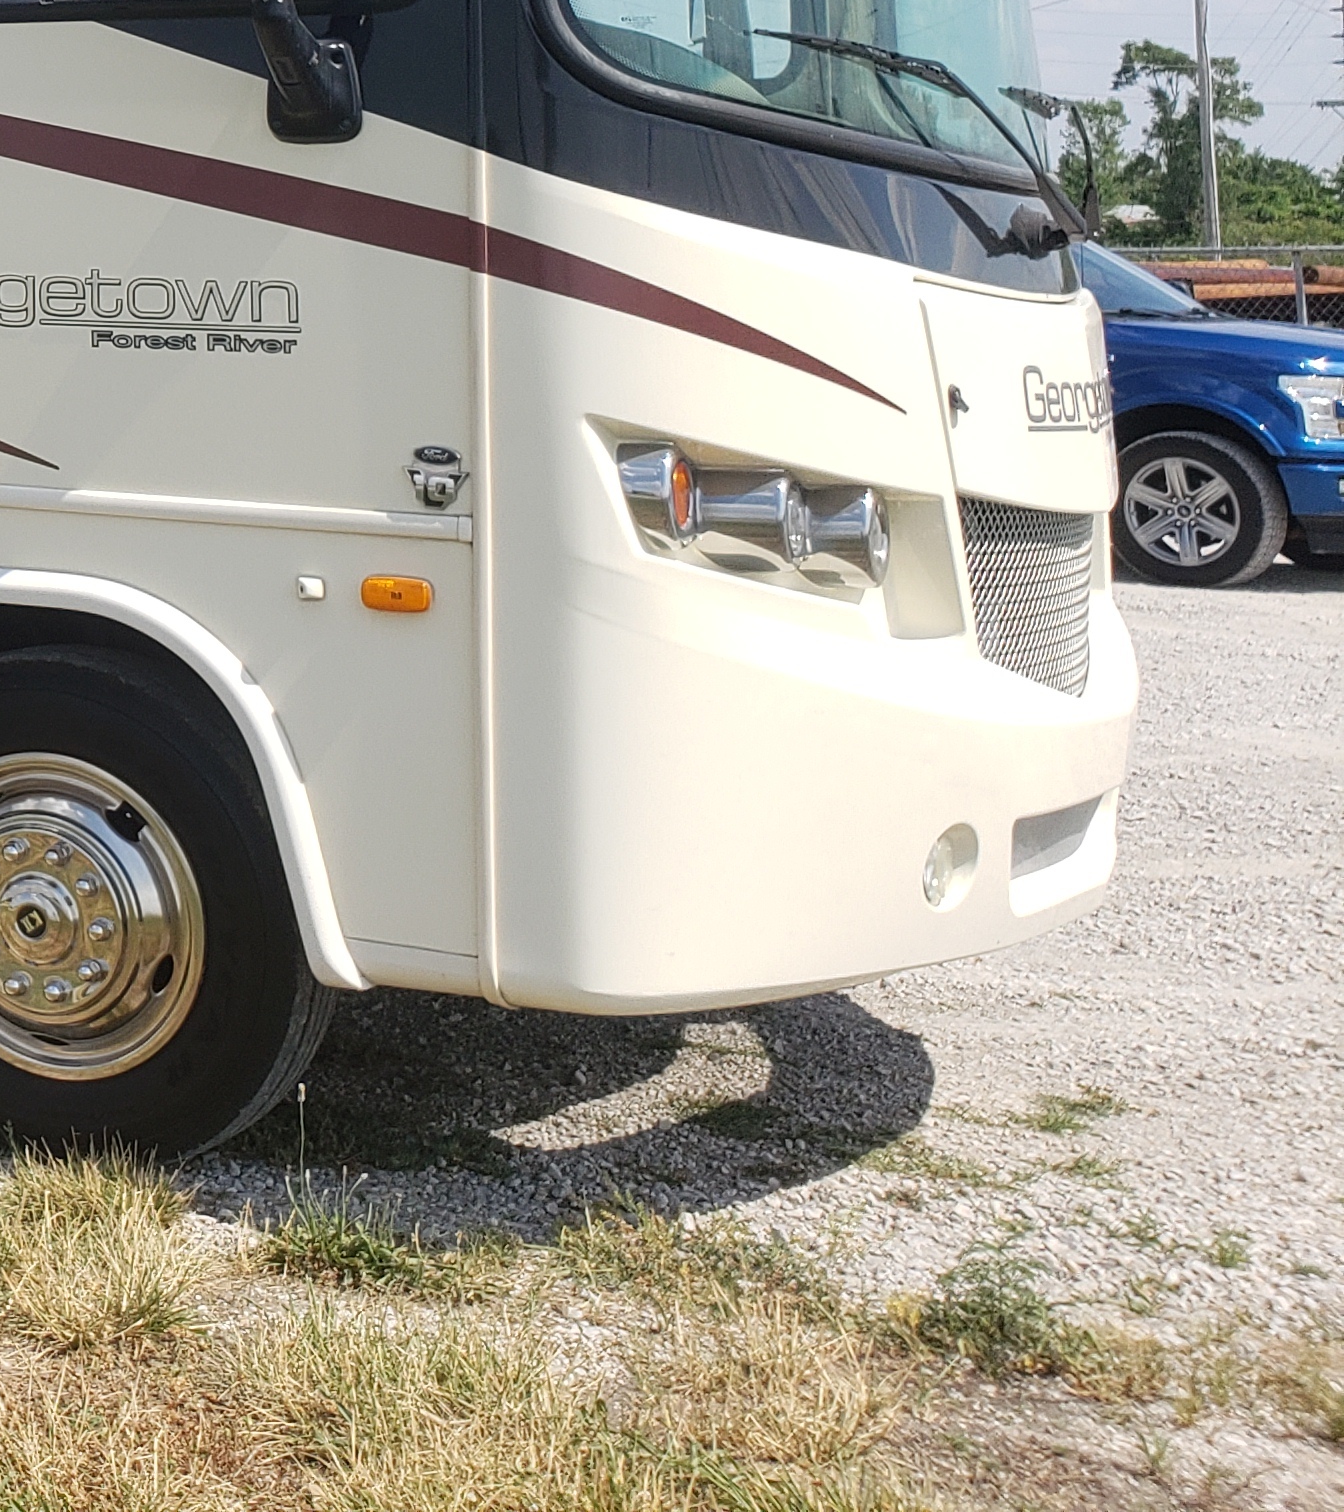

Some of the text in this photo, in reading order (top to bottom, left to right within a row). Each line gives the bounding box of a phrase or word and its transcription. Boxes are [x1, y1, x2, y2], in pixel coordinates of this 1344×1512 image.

[90, 329, 298, 355] Forest River
[1022, 364, 1112, 434] Georget
[421, 448, 449, 462] Ford
